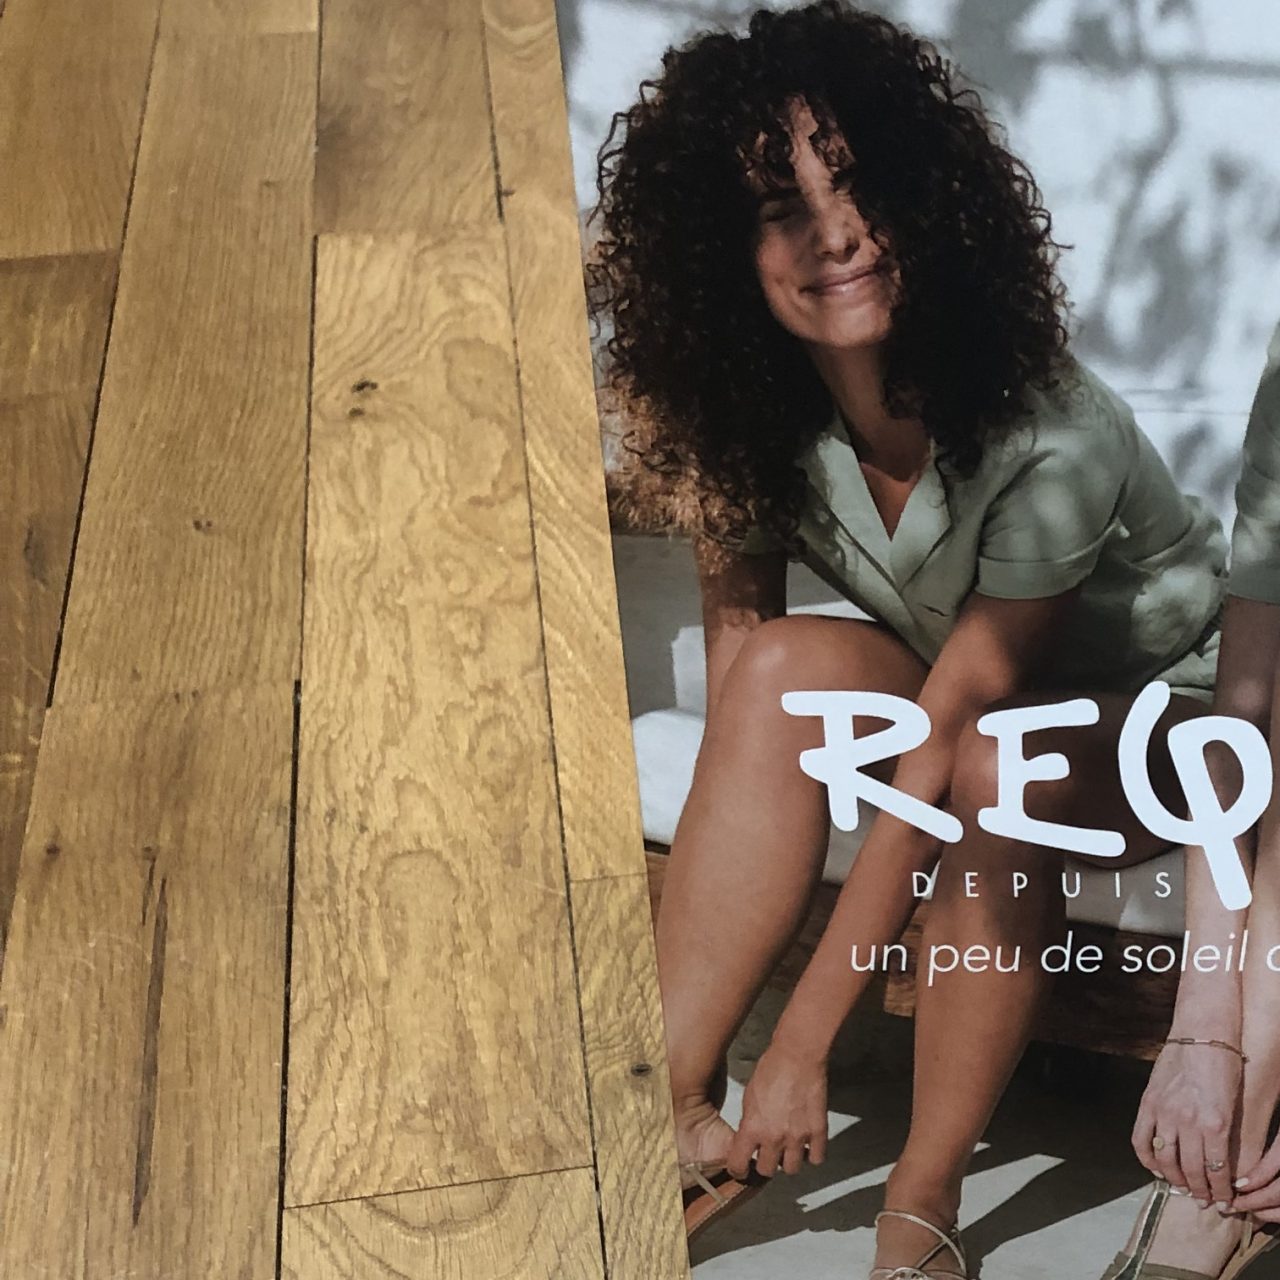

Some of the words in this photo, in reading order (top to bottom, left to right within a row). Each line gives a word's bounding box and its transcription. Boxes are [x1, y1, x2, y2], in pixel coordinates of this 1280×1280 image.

[911, 870, 1172, 899] DEPUIS
[850, 942, 908, 973] un
[927, 942, 1021, 987] peu
[1040, 930, 1104, 973] de
[1121, 929, 1250, 973] soleil
